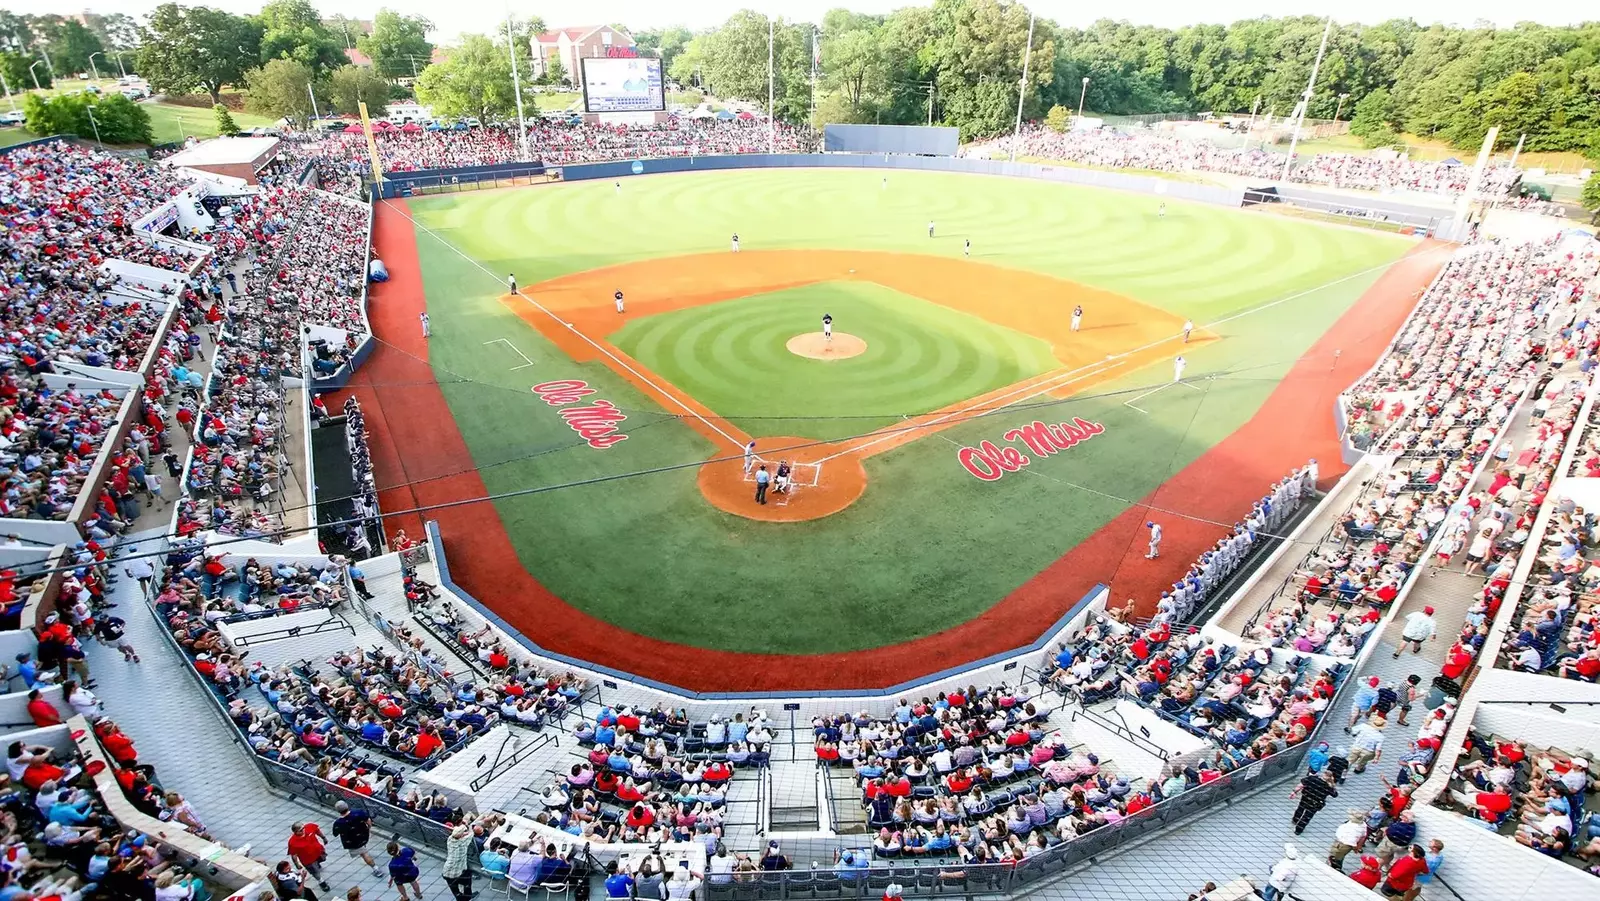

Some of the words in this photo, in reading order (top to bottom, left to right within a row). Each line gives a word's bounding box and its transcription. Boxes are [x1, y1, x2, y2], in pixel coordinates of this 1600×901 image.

[532, 380, 597, 406] Ole
[557, 400, 628, 449] Miss
[958, 440, 1030, 481] Ole
[1003, 417, 1105, 458] Miss
